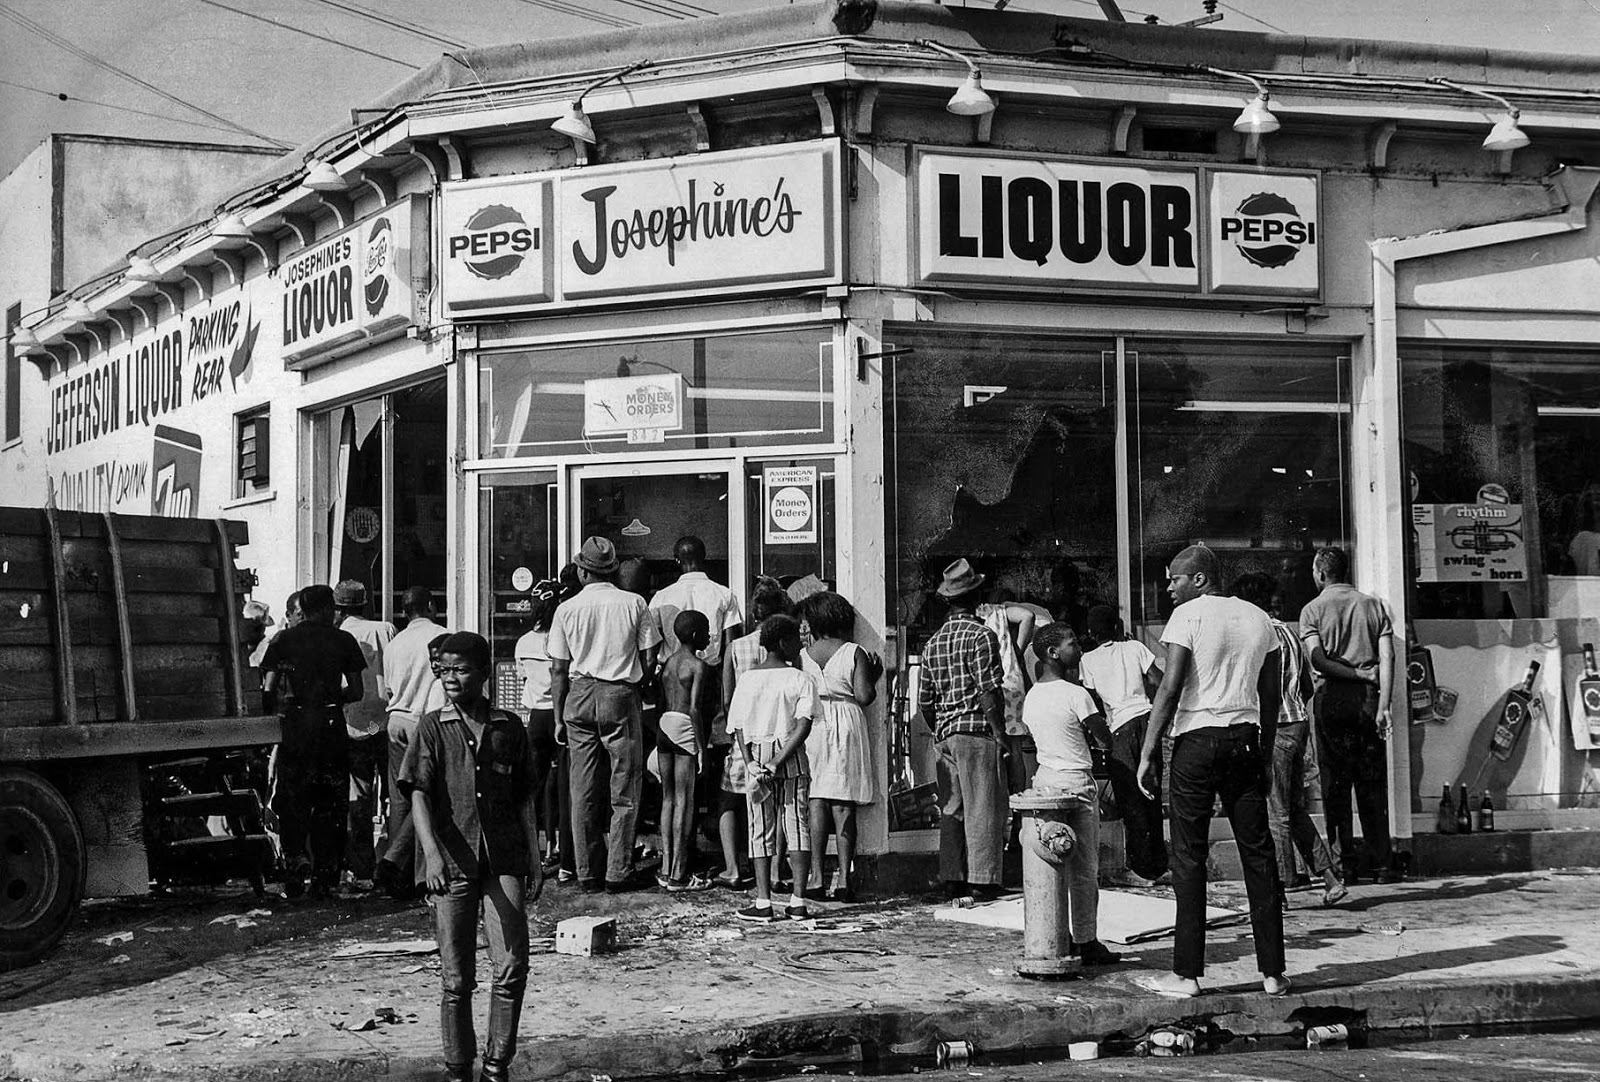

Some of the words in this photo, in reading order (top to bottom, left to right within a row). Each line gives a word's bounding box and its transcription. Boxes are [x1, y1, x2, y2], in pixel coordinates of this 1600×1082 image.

[572, 177, 803, 275] Josephine's
[939, 173, 1195, 268] LIQUOR
[1221, 217, 1315, 245] PEPSI
[449, 227, 541, 259] PEPSI
[284, 236, 351, 288] JOSEPHINE'S
[283, 265, 353, 346] LIQUOR
[187, 300, 240, 362] PARKING
[47, 359, 120, 456] JEFFERSON
[126, 330, 181, 427] LIQUOR
[191, 356, 224, 404] REAR
[626, 391, 673, 404] MONEY
[627, 403, 673, 416] ORDERS
[116, 461, 148, 504] DRINK
[769, 469, 813, 477] AMERICAN
[775, 499, 807, 508] Money
[775, 508, 807, 517] Orders
[1457, 507, 1507, 519] rhythm
[1443, 555, 1485, 568] swing
[1489, 568, 1523, 579] horn
